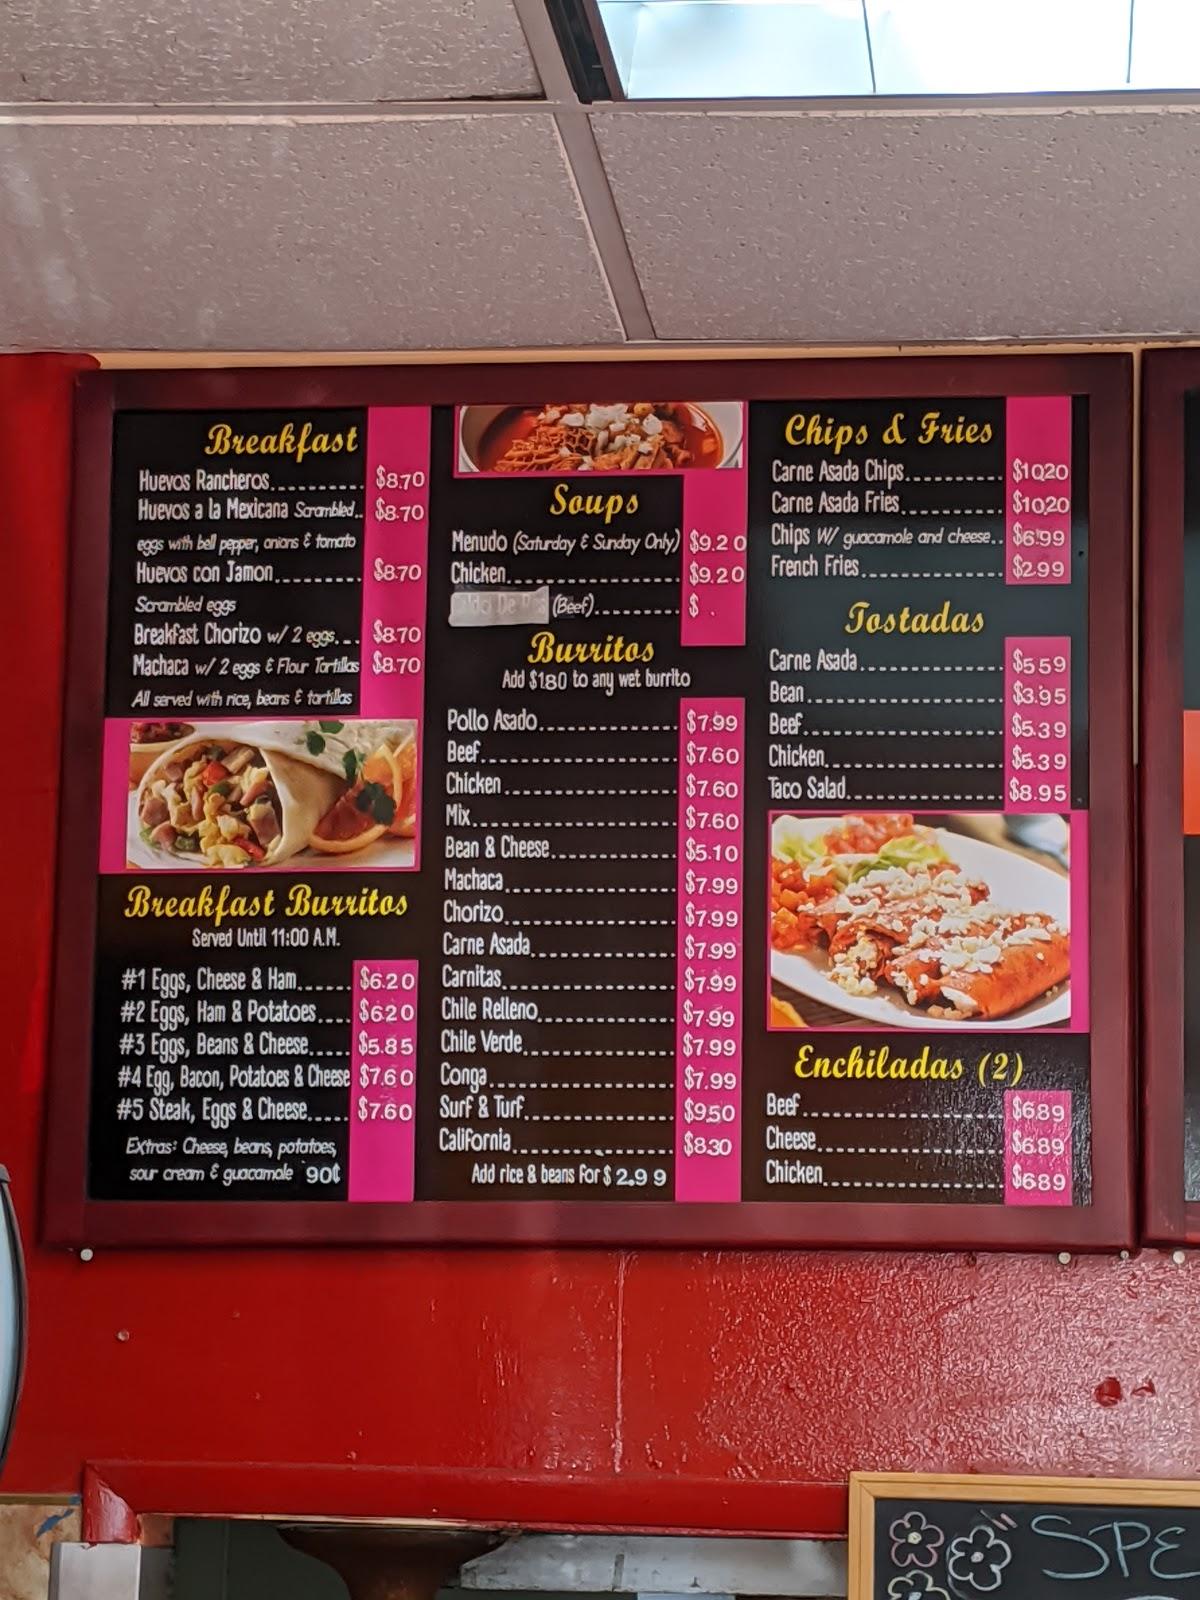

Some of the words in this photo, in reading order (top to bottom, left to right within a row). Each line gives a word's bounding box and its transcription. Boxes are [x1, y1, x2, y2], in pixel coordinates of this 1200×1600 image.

[204, 422, 358, 462] Breakfast
[785, 414, 868, 454] Chips
[882, 413, 907, 444] &
[918, 412, 993, 444] Fries
[139, 470, 190, 491] Huevos
[196, 469, 269, 489] Rancheros
[772, 460, 813, 482] Carne
[819, 459, 859, 481] Asada
[865, 459, 904, 488] Chips
[138, 499, 190, 520] Huevos
[195, 502, 202, 519] a
[208, 498, 220, 519] la
[227, 498, 288, 519] Mexicana
[550, 484, 639, 524] Soups
[772, 491, 813, 514] Carne
[818, 491, 859, 514] Asada
[865, 491, 899, 513] Fries
[137, 539, 164, 556] eggs
[168, 534, 193, 550] with
[197, 534, 216, 549] bell
[219, 538, 259, 555] pepper,
[264, 536, 299, 549] onions
[316, 533, 356, 548] tomato
[452, 530, 507, 552] Menudo
[513, 530, 576, 556] (Saturday
[593, 534, 640, 554] Sunday
[645, 532, 680, 553] Only)
[771, 523, 810, 553] Chips
[844, 530, 913, 549] guacamole
[918, 528, 943, 544] and
[948, 529, 991, 544] cheese
[136, 562, 187, 583] Huevos
[193, 565, 220, 582] con
[226, 561, 273, 582] Jamon
[451, 561, 506, 584] Chicken
[771, 555, 819, 577] French
[825, 555, 859, 577] Fries
[136, 596, 203, 613] Scrambled
[206, 599, 236, 617] eggs
[552, 594, 594, 618] (Beef)
[844, 601, 984, 635] Tostadas
[134, 623, 199, 645] Breakfast
[204, 622, 261, 644] Chorizo
[306, 630, 335, 648] eggs
[527, 632, 654, 663] Burritos
[133, 654, 189, 676] Machaca
[232, 662, 260, 680] eggs
[277, 658, 308, 674] Flour
[314, 656, 359, 673] Tortillas
[770, 649, 811, 672] Carne
[817, 649, 857, 671] Asada
[502, 669, 525, 688] Add
[573, 669, 588, 688] to
[592, 672, 614, 696] any
[618, 670, 640, 687] wet
[646, 668, 690, 687] burrito
[770, 681, 803, 703] Bean
[131, 691, 150, 708] All
[154, 691, 191, 707] served
[256, 690, 288, 705] beans
[306, 689, 352, 705] tortillas
[448, 709, 488, 732] Pollo
[493, 708, 537, 730] Asado
[770, 712, 803, 735] Beef
[448, 741, 481, 763] Beef
[769, 745, 824, 768] Chicken
[446, 773, 500, 795] Chicken
[769, 776, 802, 799] Taco
[807, 776, 846, 800] Salad
[446, 803, 471, 826] Mix
[446, 836, 479, 859] Bean
[501, 836, 549, 858] Cheese
[445, 868, 503, 892] Machaca
[124, 884, 274, 926] Breakfast
[285, 884, 408, 916] Burritos
[444, 901, 503, 923] Chorizo
[192, 929, 232, 947] Served
[237, 928, 267, 947] Until
[271, 928, 308, 947] 11:00
[313, 928, 340, 947] A.M.
[443, 933, 483, 955] Carne
[489, 933, 530, 955] Asada
[122, 968, 146, 990] #1
[152, 968, 191, 999] Eggs,
[197, 967, 245, 990] Cheese
[268, 967, 296, 989] Ham
[442, 965, 501, 988] Carnitas
[120, 1001, 145, 1022] #2
[151, 1000, 190, 1031] Eggs,
[197, 1000, 226, 1022] Ham
[248, 1000, 316, 1022] Potatoes
[442, 998, 476, 1020] Chile
[483, 997, 538, 1020] Relleno
[119, 1033, 145, 1055] #3
[151, 1032, 190, 1064] Eggs,
[197, 1033, 238, 1055] Beans
[260, 1032, 308, 1054] Cheese
[441, 1031, 475, 1052] Chile
[481, 1031, 522, 1052] Verde
[794, 1044, 963, 1080] Enchiladas
[977, 1052, 1024, 1088] (2)
[118, 1066, 141, 1088] #4
[146, 1066, 175, 1096] Egg,
[181, 1065, 223, 1090] Bacon,
[230, 1065, 289, 1087] Potatoes
[308, 1064, 350, 1087] Cheese
[441, 1063, 487, 1093] Conga
[116, 1098, 143, 1120] #5
[150, 1097, 196, 1123] Steak,
[202, 1097, 236, 1129] Eggs
[258, 1097, 308, 1119] Cheese
[440, 1097, 472, 1118] Surf
[494, 1096, 525, 1118] Turf
[766, 1093, 800, 1116] Beef
[126, 1138, 178, 1154] Extras:
[277, 1138, 337, 1159] potatoes,
[439, 1129, 511, 1152] California
[766, 1126, 816, 1150] Cheese
[129, 1169, 158, 1181] sour
[163, 1168, 204, 1181] cream
[223, 1165, 292, 1186] guacamole
[472, 1165, 495, 1184] Add
[500, 1165, 523, 1183] rice
[541, 1164, 574, 1183] beans
[580, 1164, 600, 1183] for
[766, 1160, 823, 1184] Chicken
